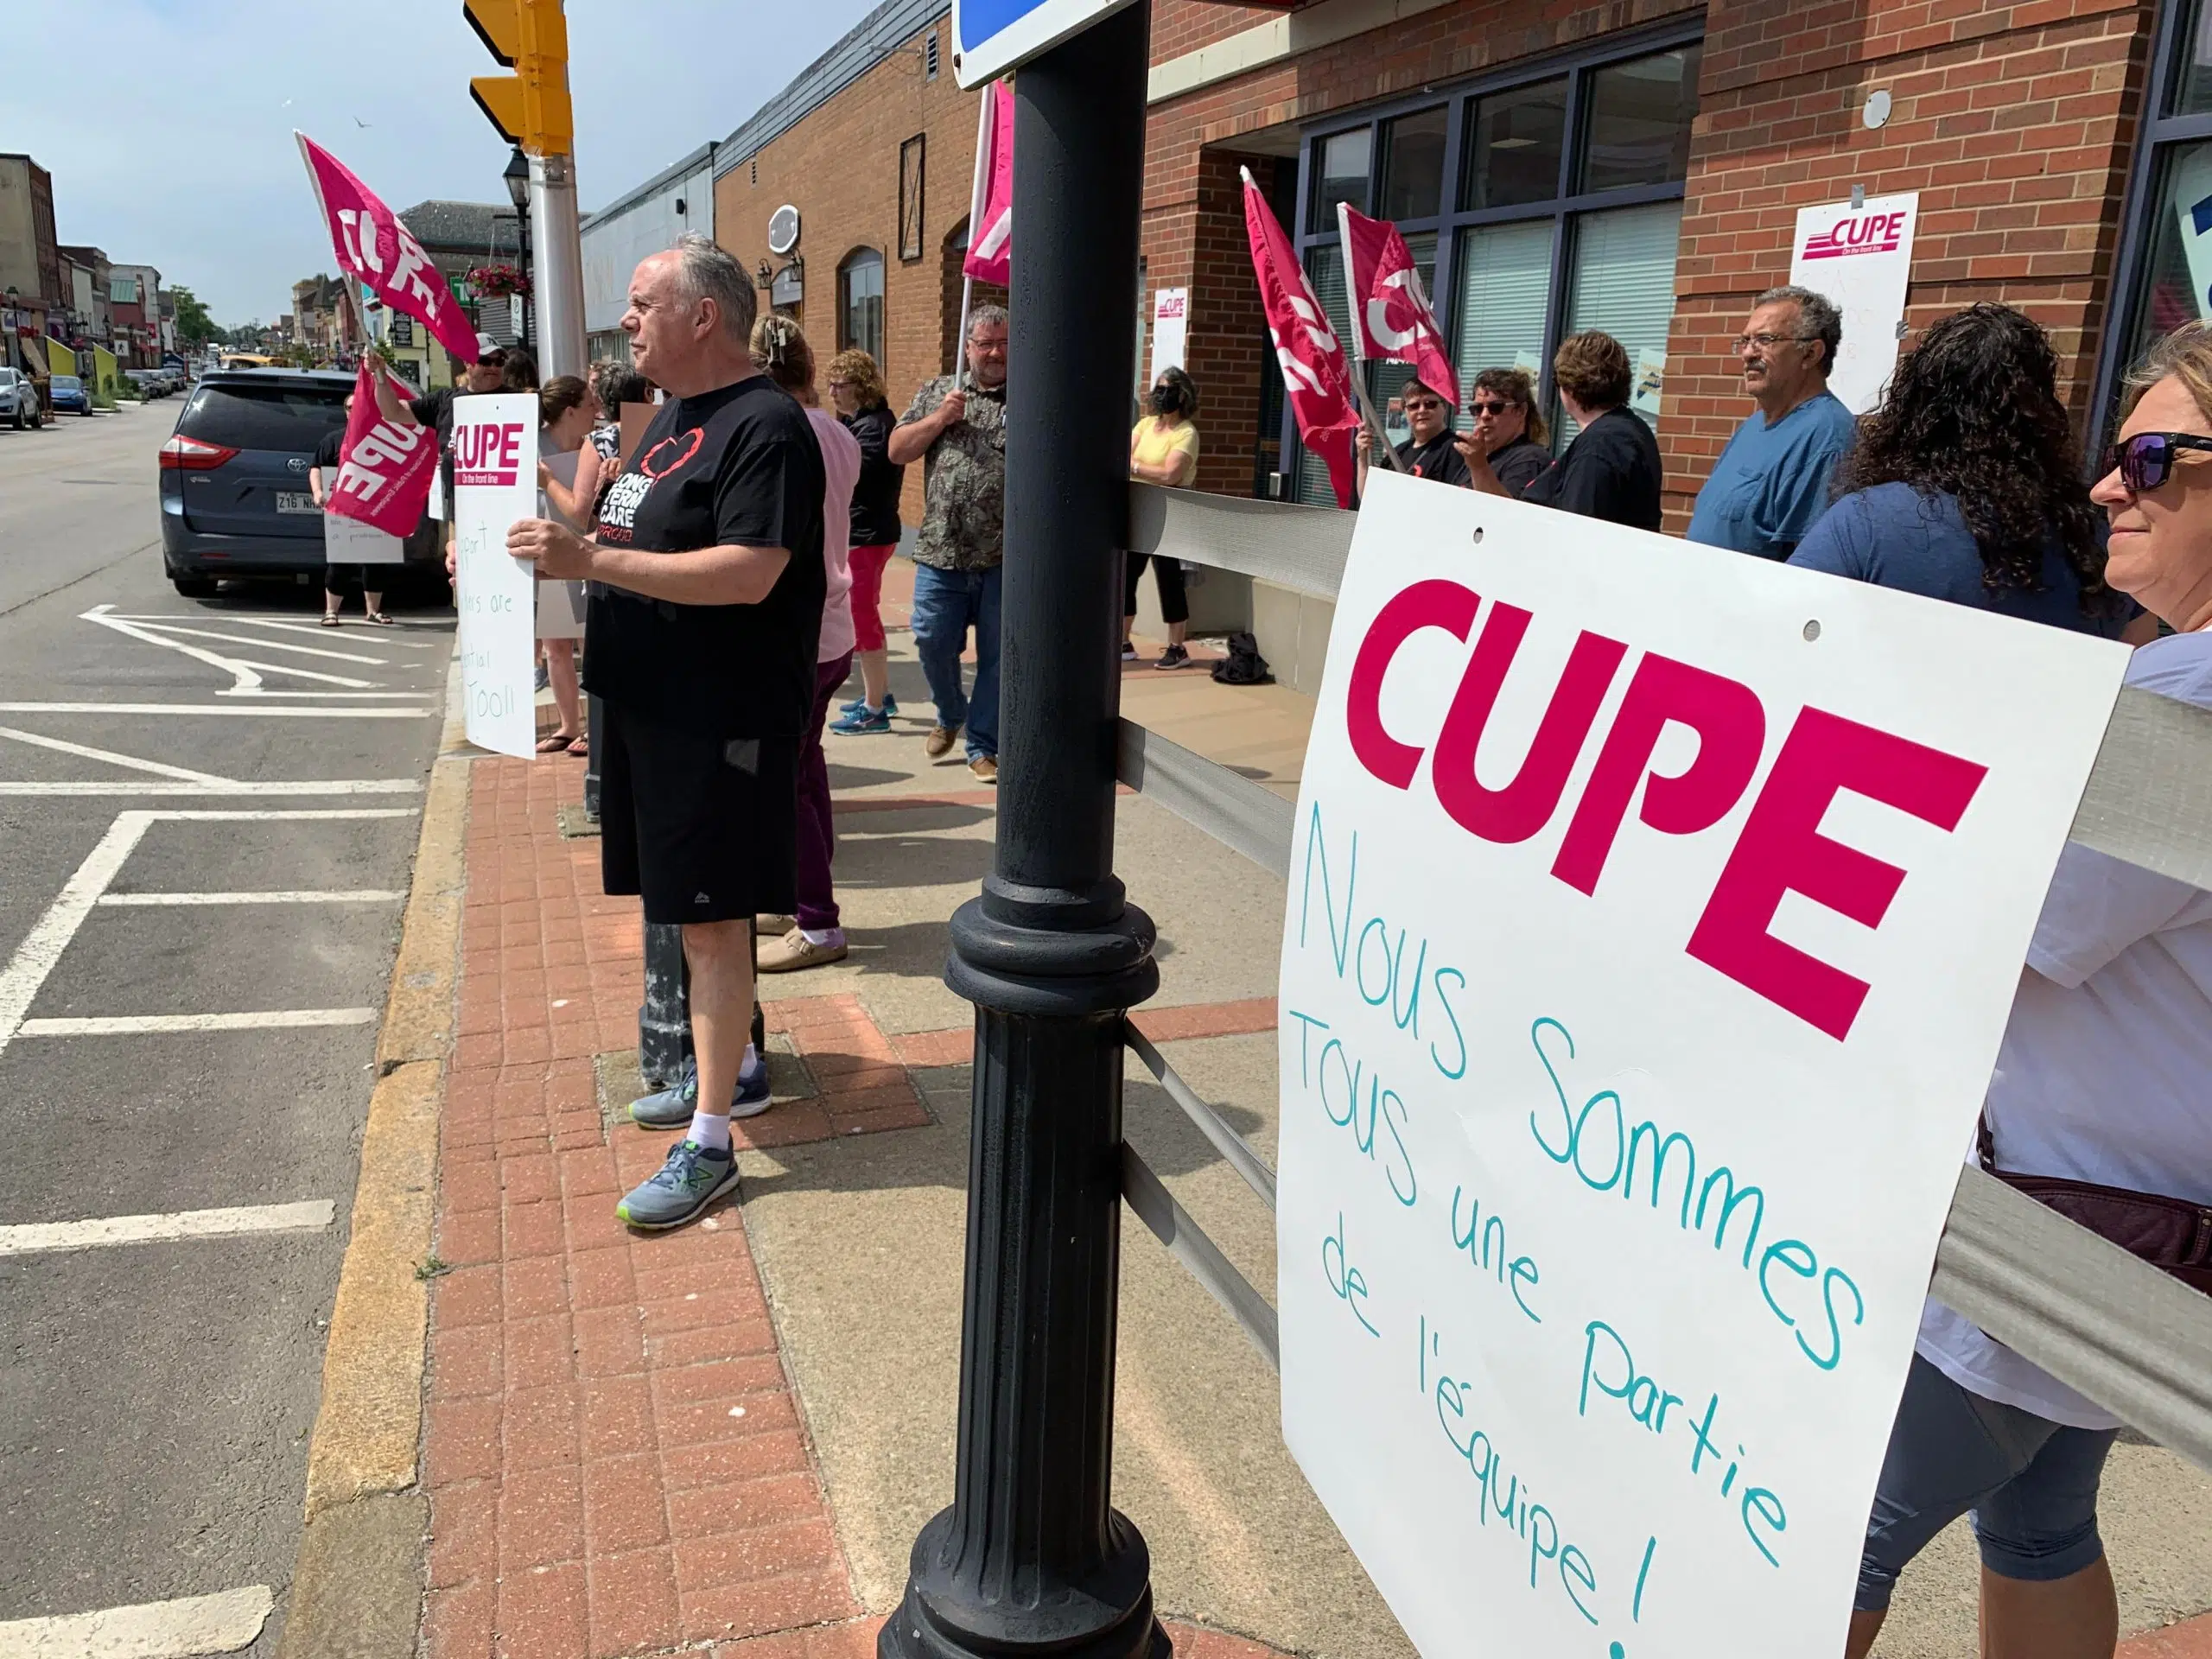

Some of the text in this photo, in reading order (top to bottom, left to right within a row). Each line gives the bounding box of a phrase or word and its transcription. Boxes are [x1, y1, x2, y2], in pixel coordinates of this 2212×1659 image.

[1830, 212, 1907, 247] CUPE
[454, 423, 524, 469] CUPE
[605, 487, 645, 510] TERM
[612, 472, 654, 494] LONG
[279, 497, 297, 509] Z16
[600, 504, 635, 528] CARE
[490, 594, 512, 613] are
[1348, 580, 1987, 1041] CUPE
[1300, 800, 1466, 1080] Nous
[1289, 1010, 1417, 1207] Tous
[1452, 1185, 1542, 1323] une
[1322, 1211, 1381, 1338] de
